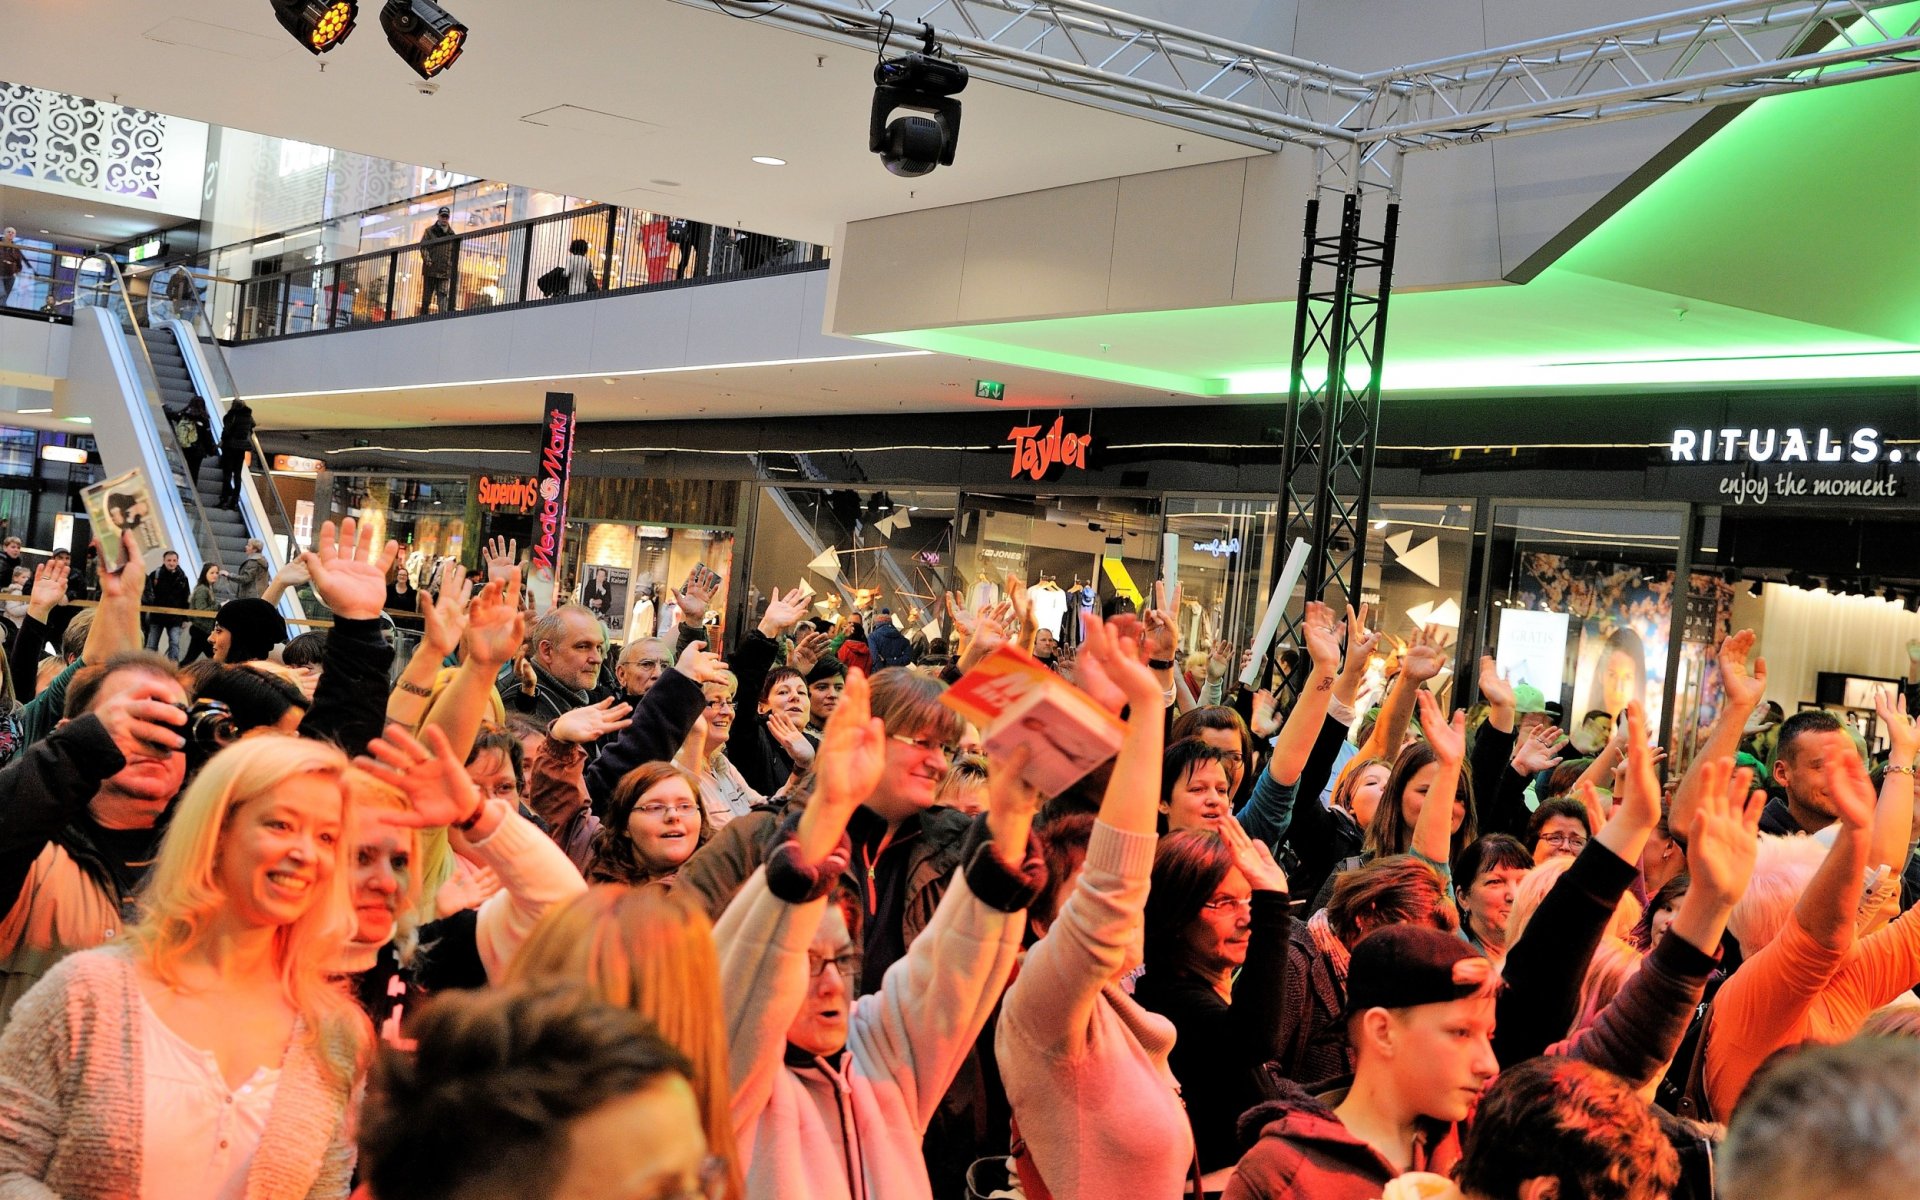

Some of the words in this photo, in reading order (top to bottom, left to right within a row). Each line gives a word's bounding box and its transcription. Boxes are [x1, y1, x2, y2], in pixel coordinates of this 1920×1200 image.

[543, 409, 568, 485] Markt
[1008, 416, 1092, 480] Tayler
[1719, 472, 1768, 504] enjoy
[1775, 472, 1807, 496] the
[1813, 474, 1898, 496] moment
[533, 500, 559, 579] Media
[993, 550, 1022, 560] JONES
[1685, 615, 1713, 627] UAL
[1511, 630, 1553, 645] GRATIS
